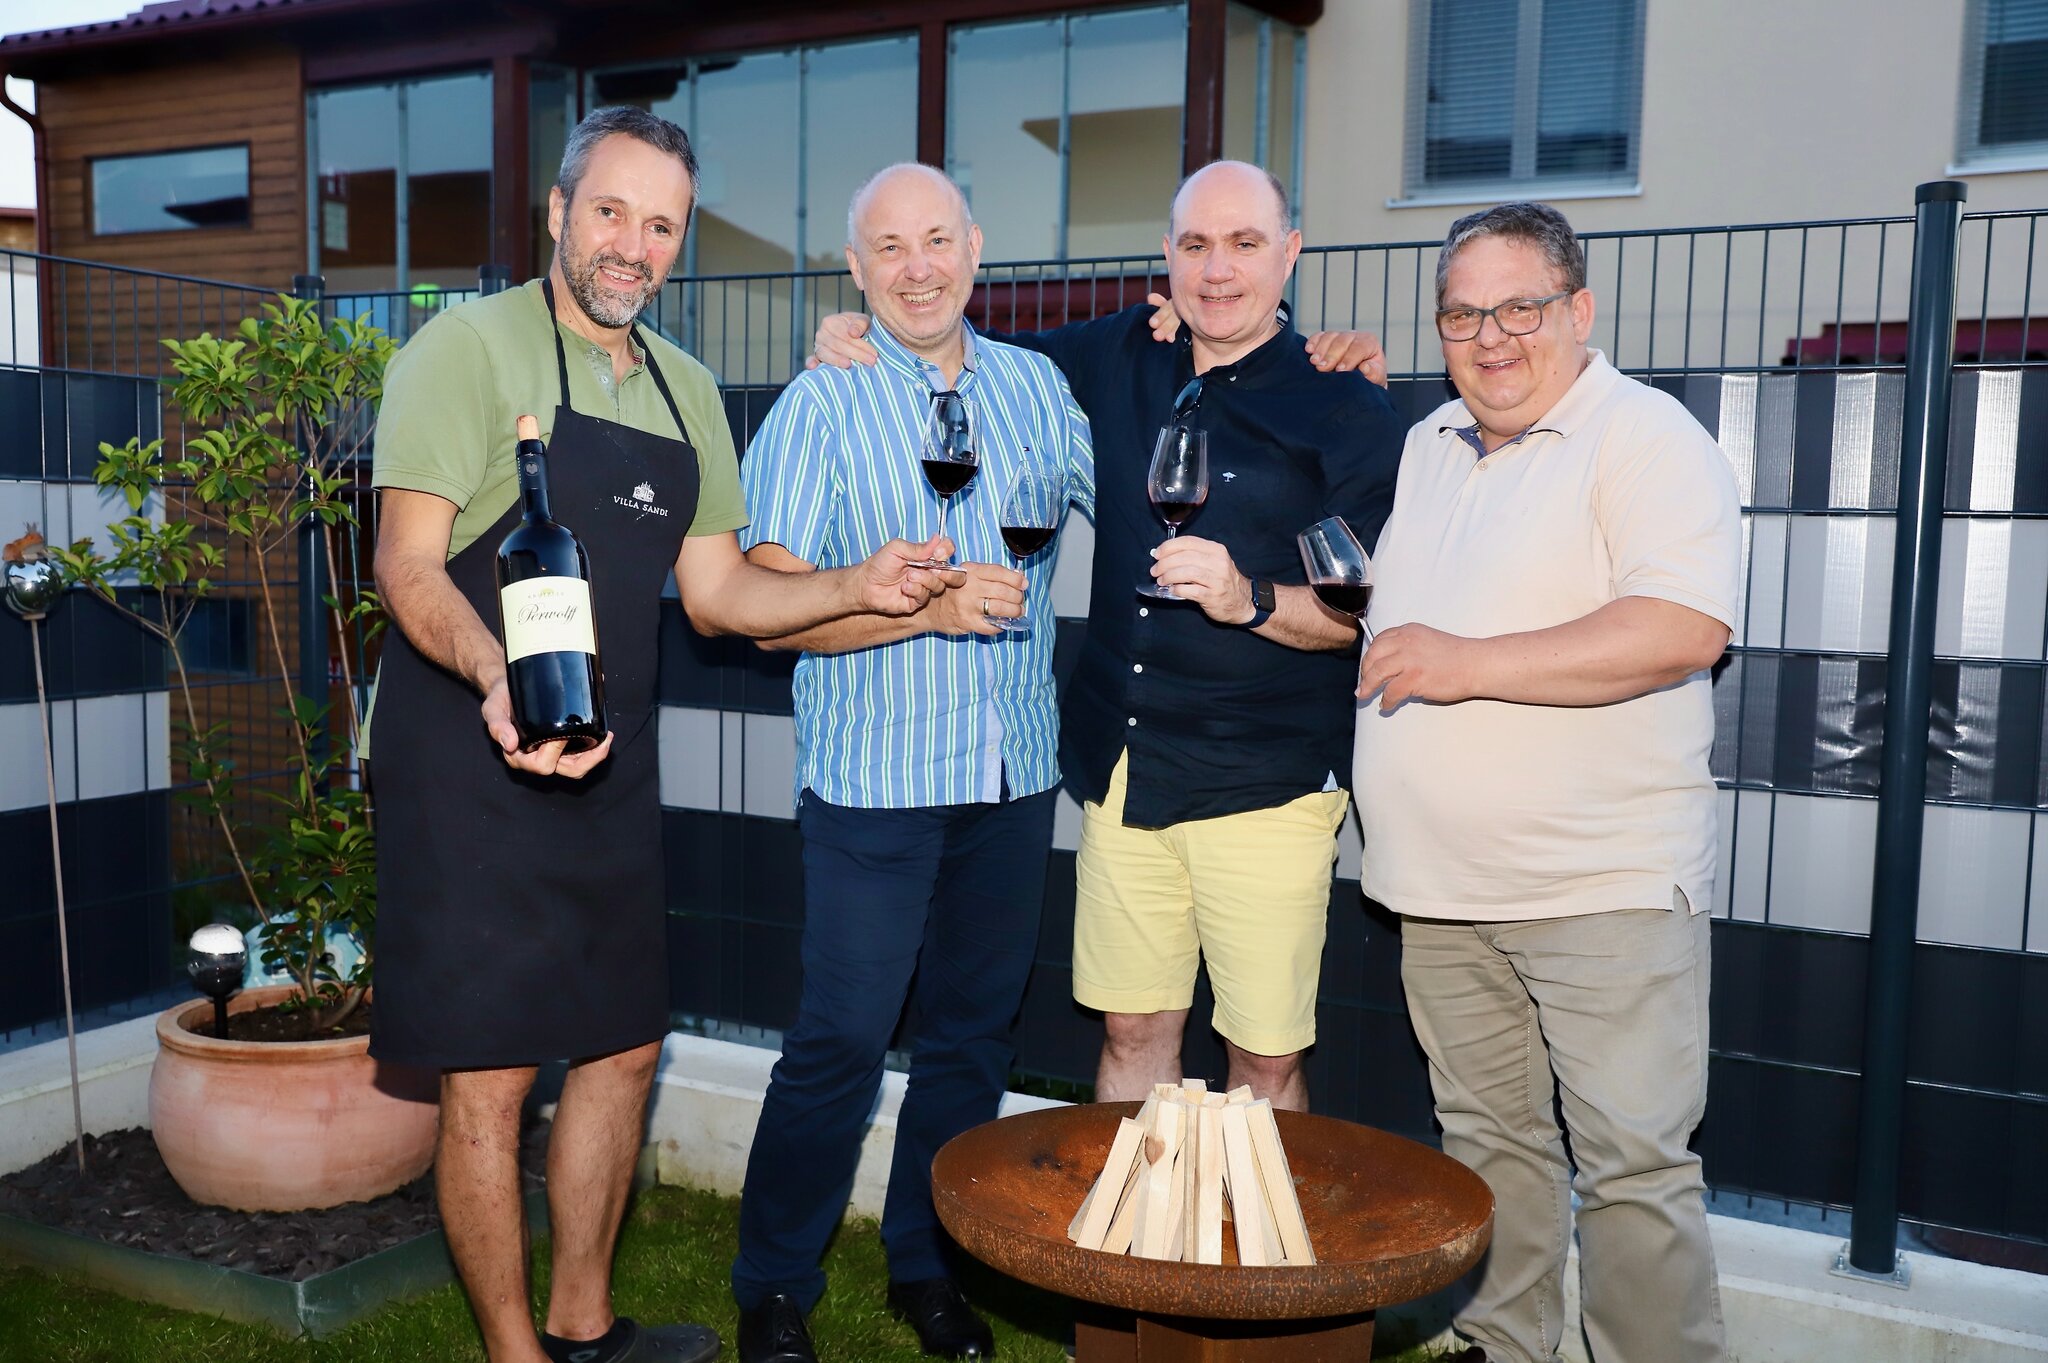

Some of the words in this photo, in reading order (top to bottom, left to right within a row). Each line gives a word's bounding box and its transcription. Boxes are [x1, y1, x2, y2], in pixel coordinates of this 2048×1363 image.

[613, 495, 640, 510] VILLA
[642, 503, 669, 517] SANDI
[517, 603, 578, 625] Perwolff
